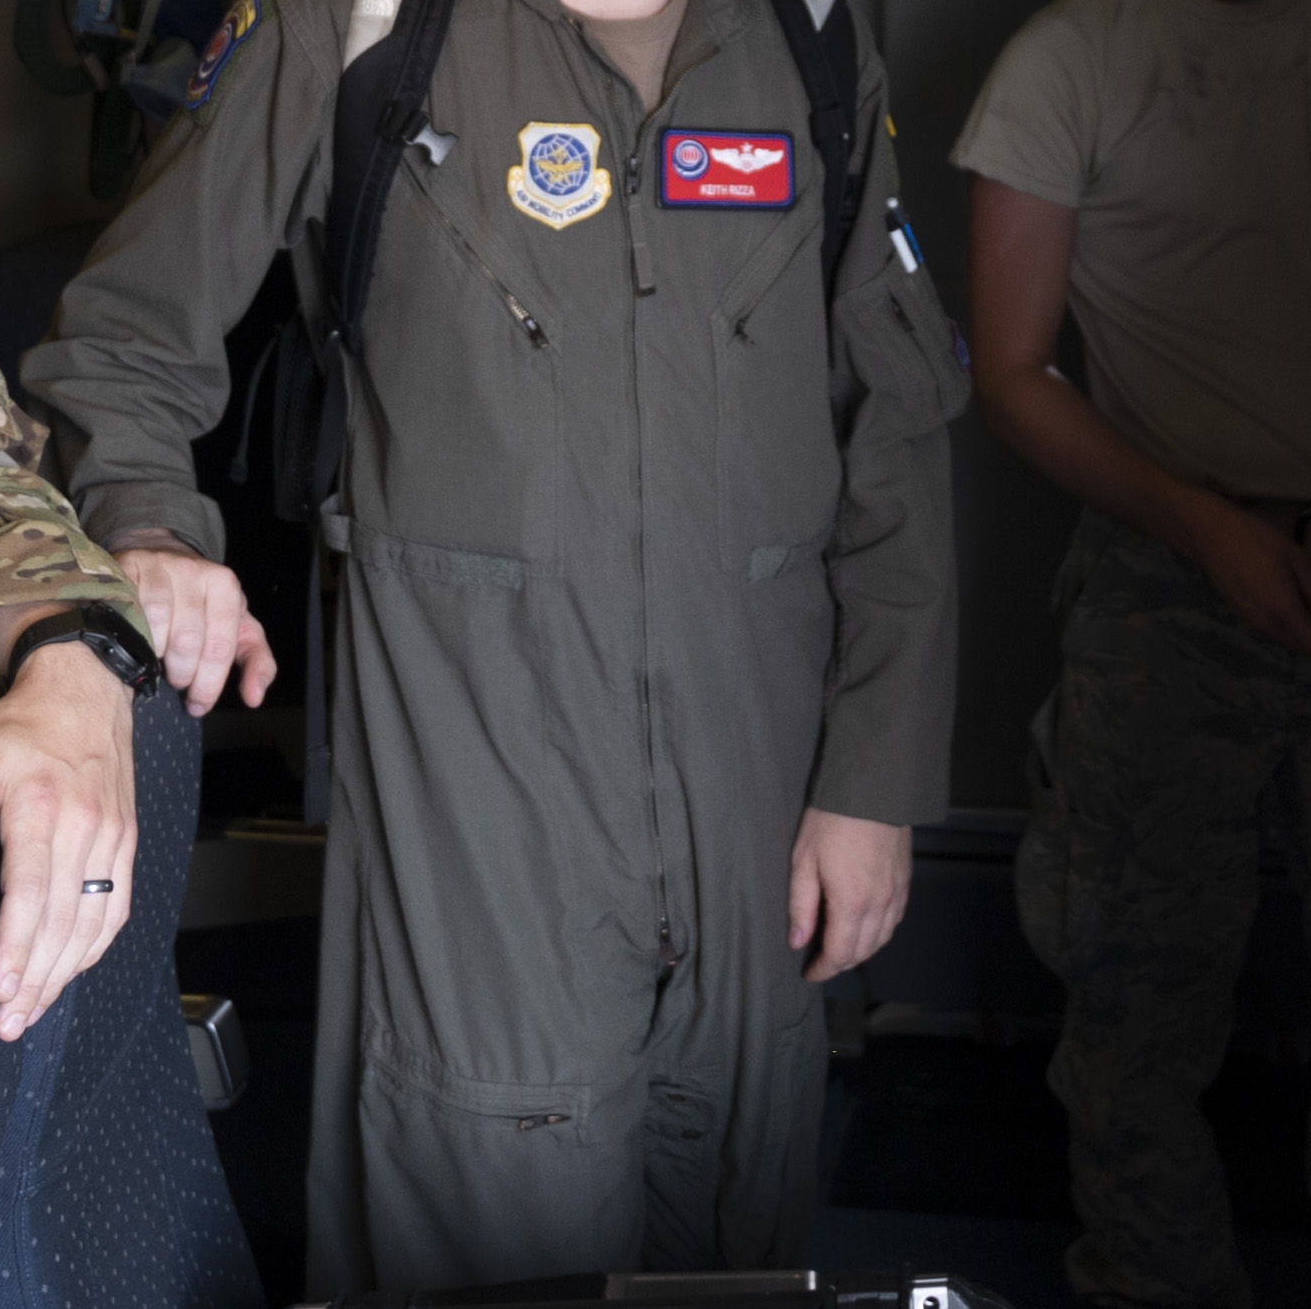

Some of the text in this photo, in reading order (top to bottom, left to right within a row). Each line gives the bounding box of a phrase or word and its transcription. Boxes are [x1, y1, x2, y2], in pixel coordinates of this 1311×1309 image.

[699, 184, 728, 197] KEITH
[528, 200, 564, 221] MOBILITY
[566, 191, 603, 218] COMMAND
